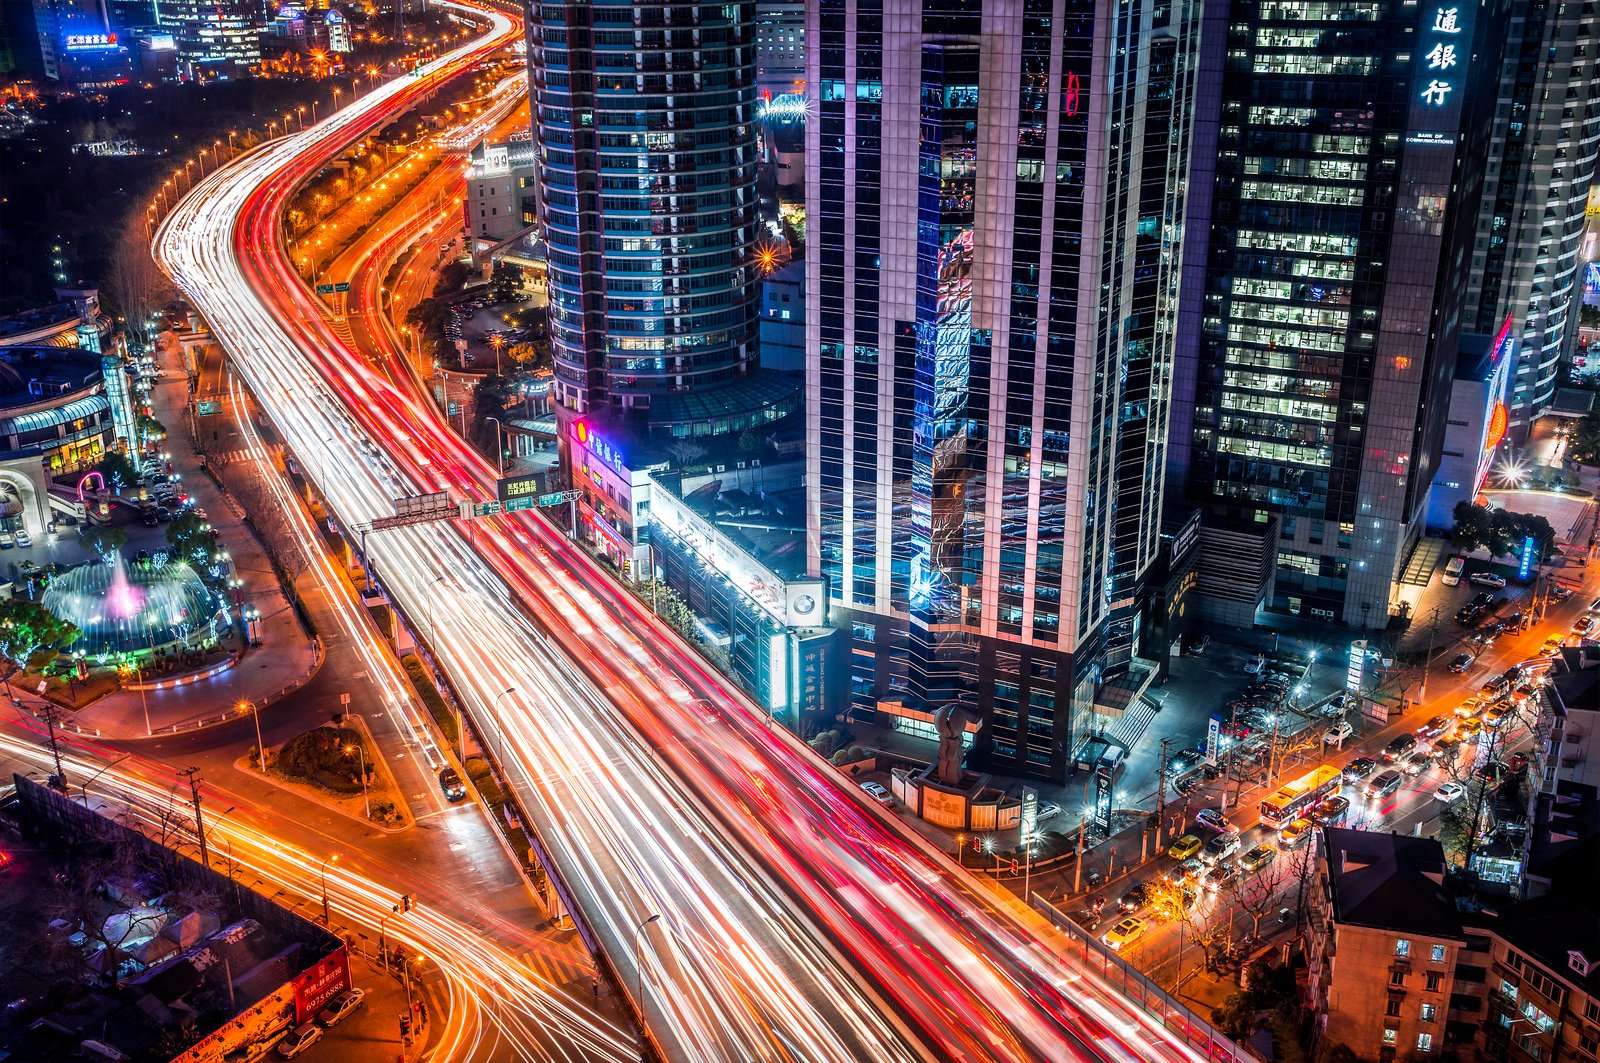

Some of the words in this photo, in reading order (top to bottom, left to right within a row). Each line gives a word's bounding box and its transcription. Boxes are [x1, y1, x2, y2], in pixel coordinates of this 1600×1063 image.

[588, 429, 622, 472] 中信银行
[306, 994, 325, 1011] 6975
